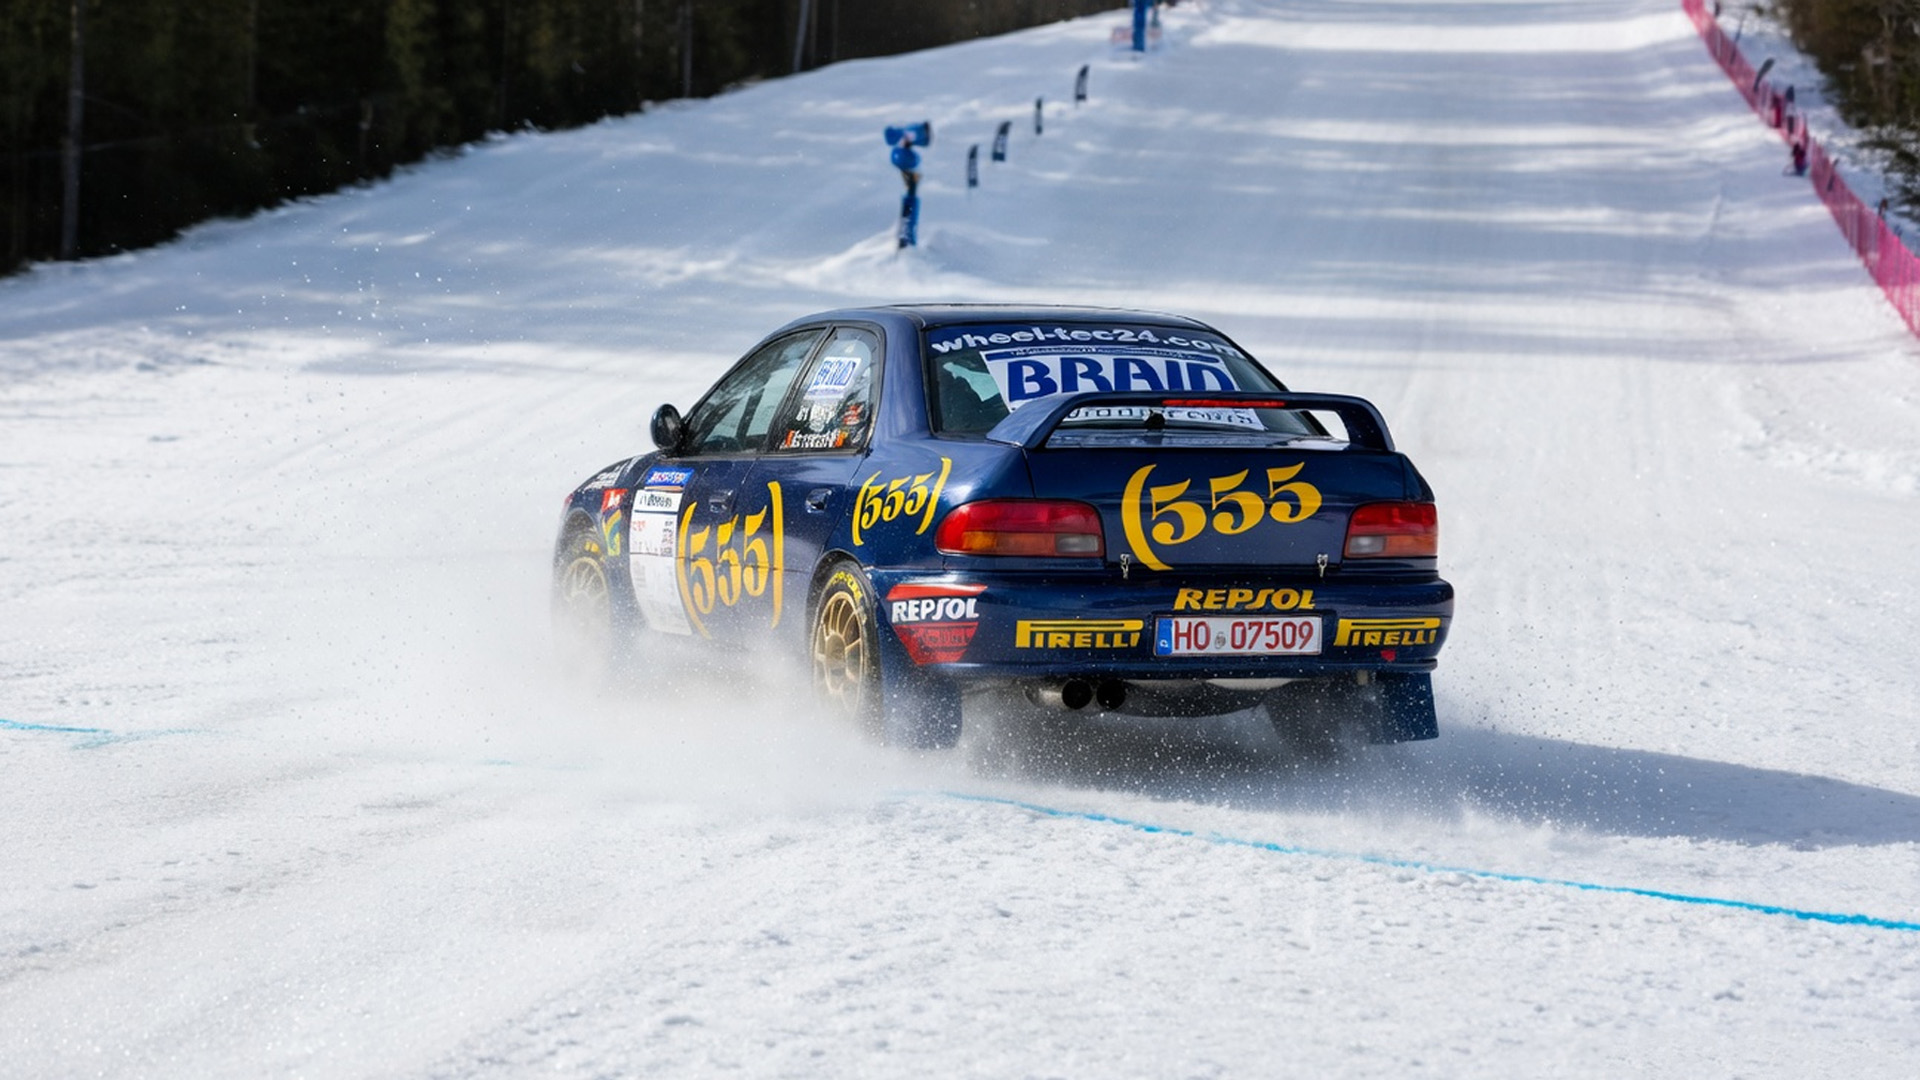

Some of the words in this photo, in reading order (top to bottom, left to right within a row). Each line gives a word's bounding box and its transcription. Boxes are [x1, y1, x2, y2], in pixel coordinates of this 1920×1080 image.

[931, 326, 1247, 360] wheel-tec24.com
[1007, 357, 1235, 401] BRAID
[891, 598, 979, 623] REPSOL
[1173, 588, 1316, 610] REPSOL
[1015, 619, 1144, 648] PIRELLI
[1174, 620, 1211, 650] HO
[1231, 620, 1314, 650] 07509
[1333, 617, 1441, 647] PIRELLI
